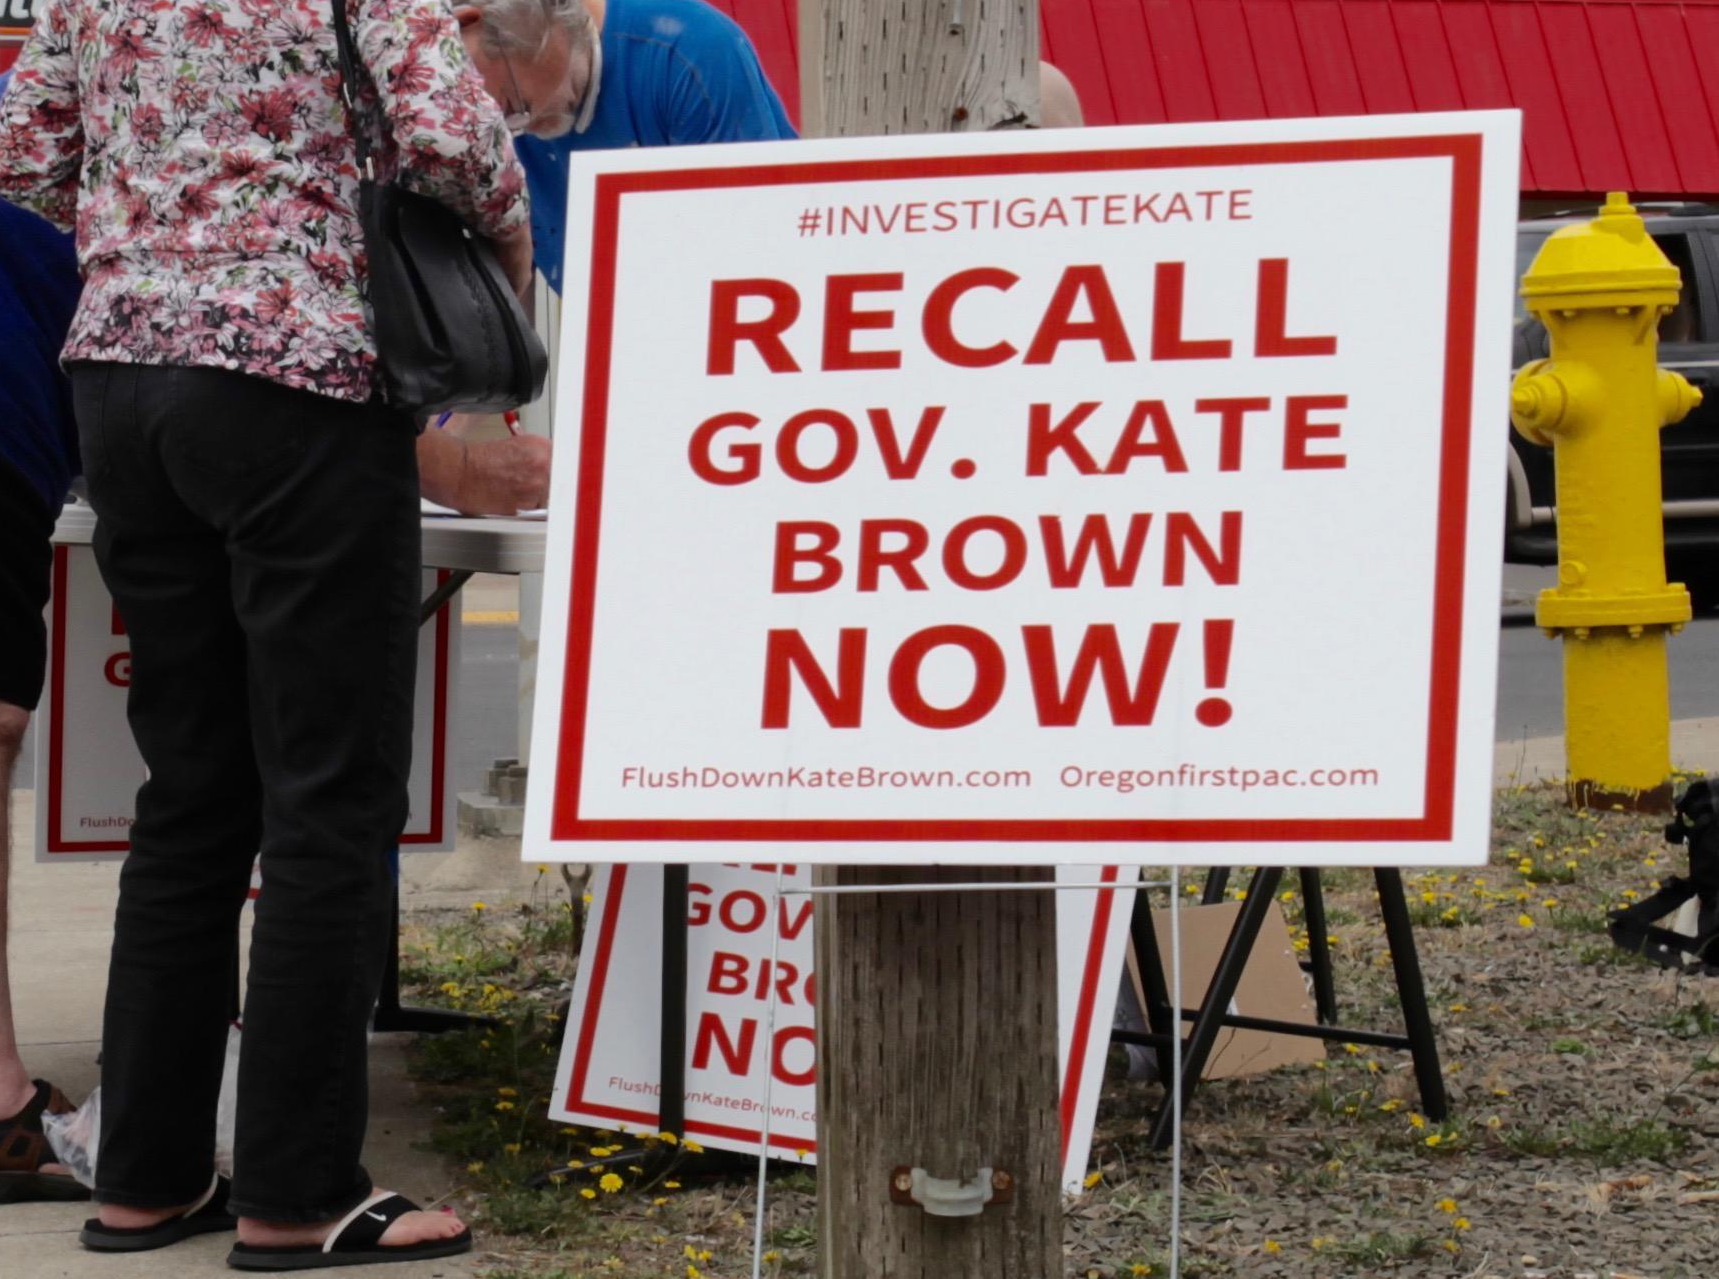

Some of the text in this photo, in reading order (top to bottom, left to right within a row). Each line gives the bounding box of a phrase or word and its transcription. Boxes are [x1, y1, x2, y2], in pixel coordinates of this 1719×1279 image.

[798, 188, 1253, 238] #INVESTIGATEKATE
[705, 257, 1338, 377] RECALL
[687, 394, 1350, 487] GOV. KATE
[771, 510, 1244, 595] BROWN
[760, 617, 1236, 731] NOW!
[621, 764, 1379, 794] FlushDownKateBrown.com Oregonfirstpac.com
[686, 882, 815, 941] GOV
[707, 950, 816, 1006] BR
[691, 1011, 817, 1087] NO
